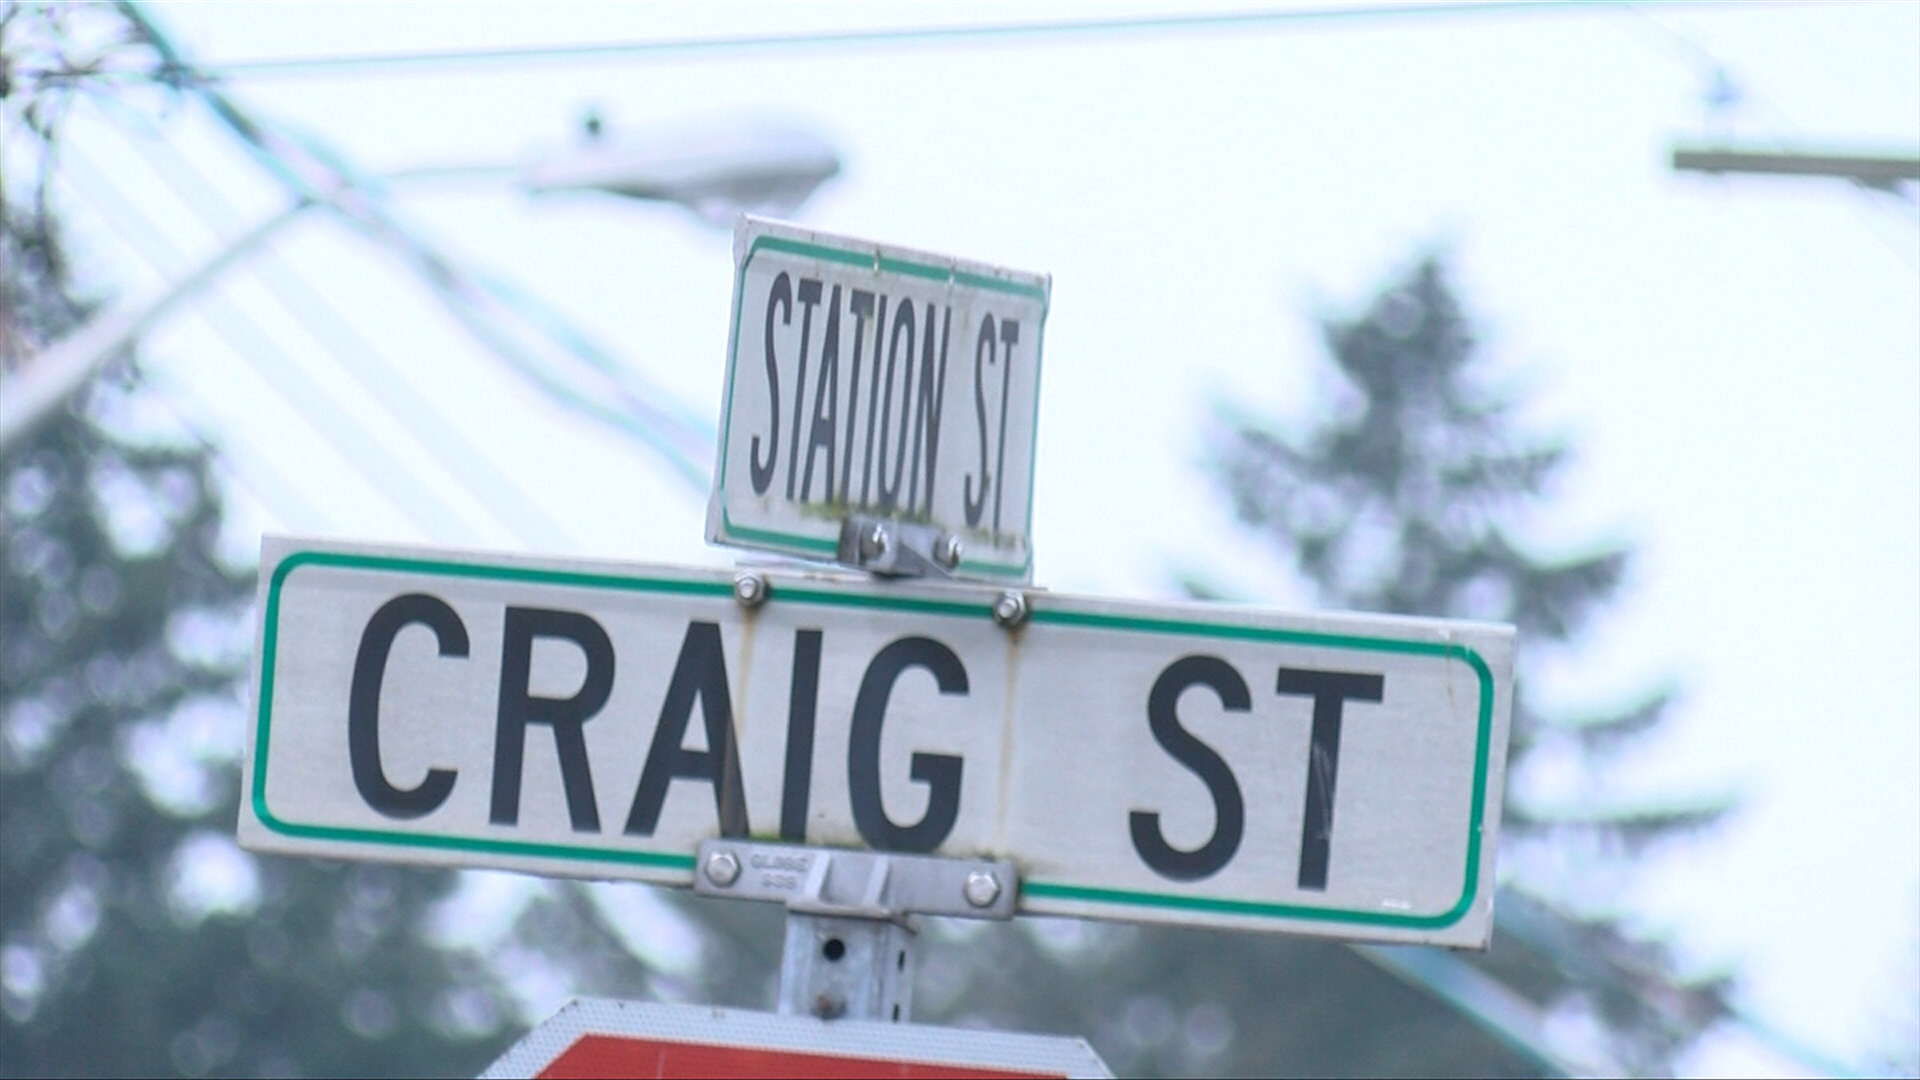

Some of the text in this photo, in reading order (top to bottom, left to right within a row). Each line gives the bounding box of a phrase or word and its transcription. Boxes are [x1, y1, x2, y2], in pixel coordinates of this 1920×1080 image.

[750, 270, 1019, 548] STATION ST
[348, 593, 1384, 890] CRAIG ST
